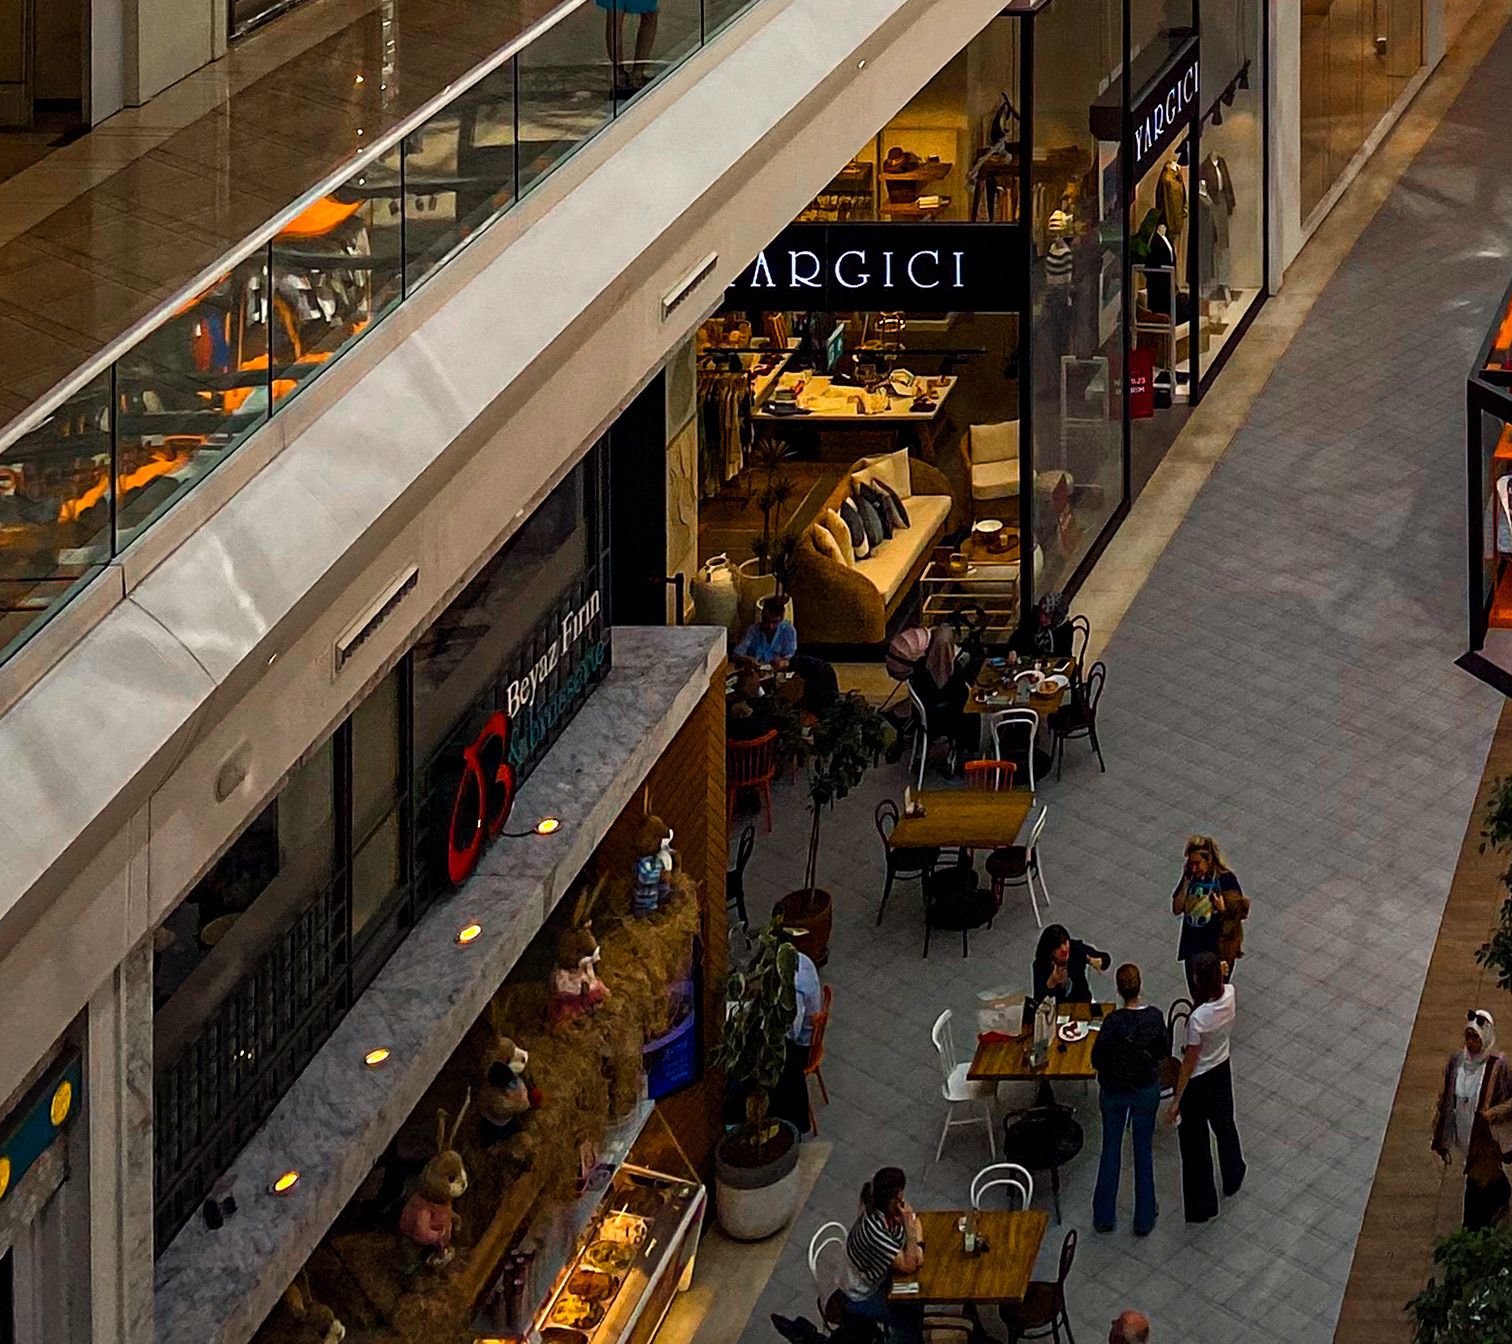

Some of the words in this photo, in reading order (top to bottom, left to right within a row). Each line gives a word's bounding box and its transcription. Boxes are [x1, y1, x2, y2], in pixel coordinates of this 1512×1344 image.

[1134, 60, 1199, 162] YARGICI
[730, 249, 965, 289] ARGICI
[506, 638, 558, 719] Beyaz
